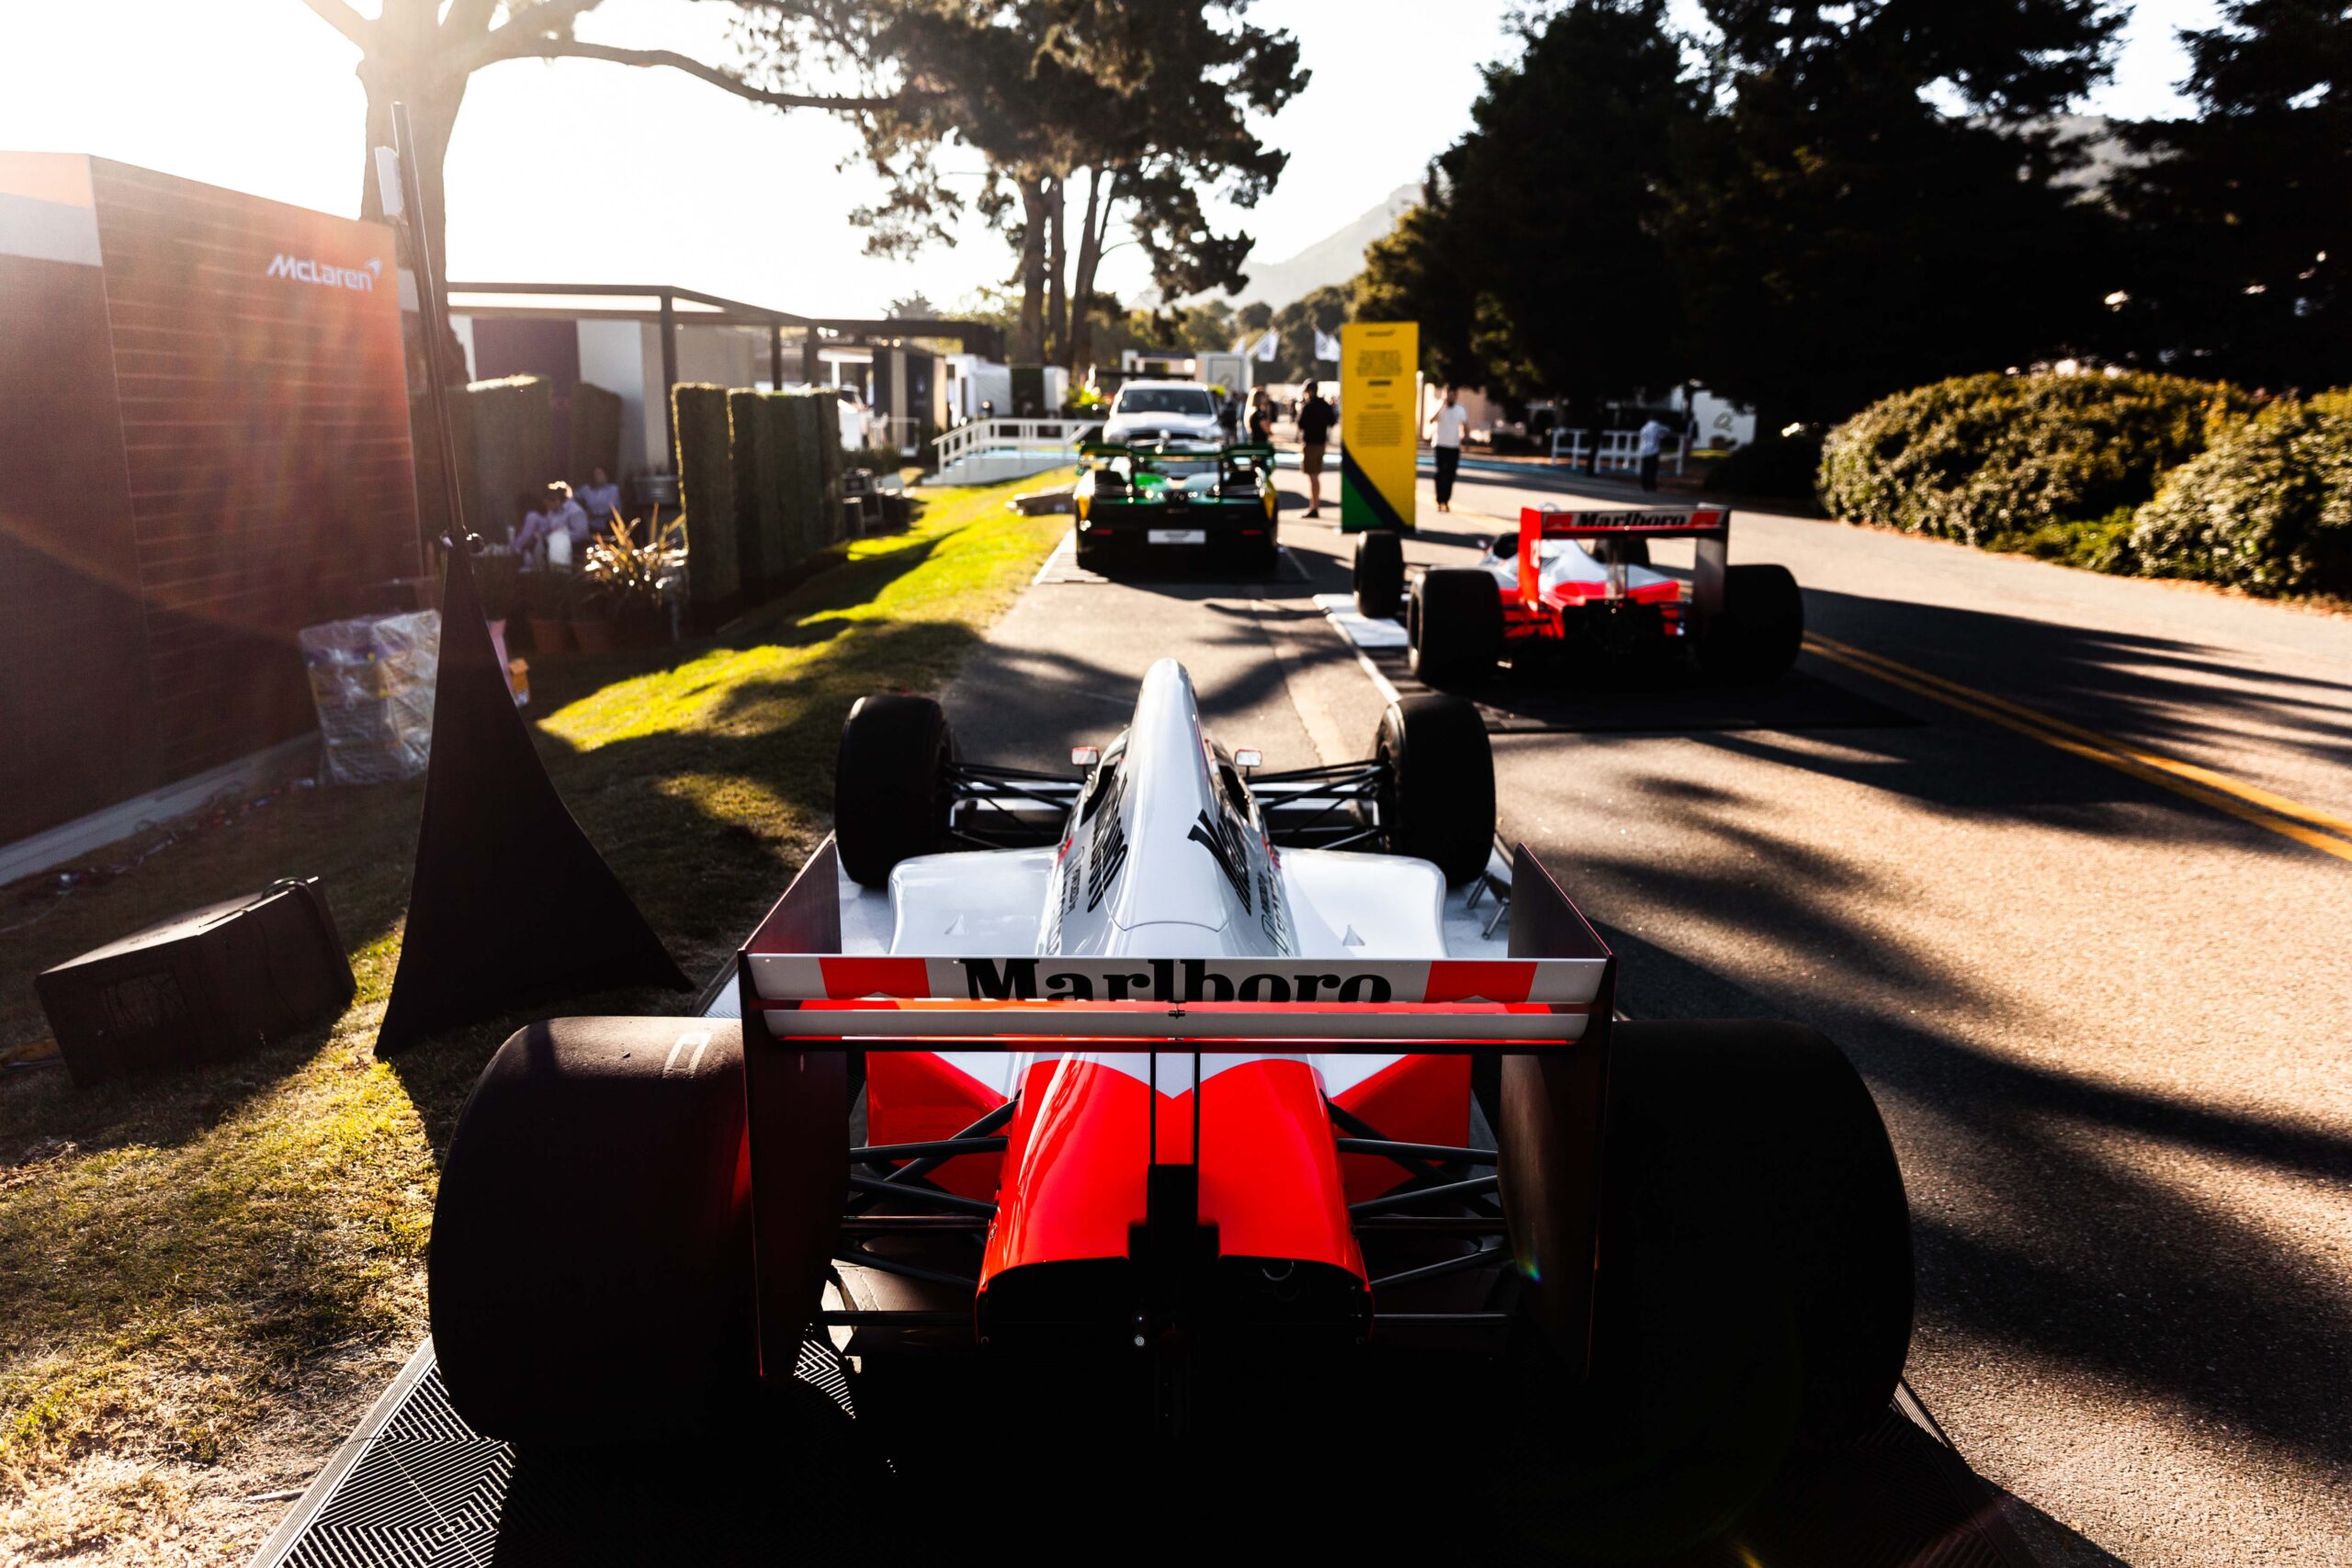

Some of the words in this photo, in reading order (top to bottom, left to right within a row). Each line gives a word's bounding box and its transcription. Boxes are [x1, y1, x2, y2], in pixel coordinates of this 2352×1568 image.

[266, 253, 373, 292] McLaren
[1577, 512, 1687, 526] Marlboro
[958, 958, 1393, 1003] Marlboro
